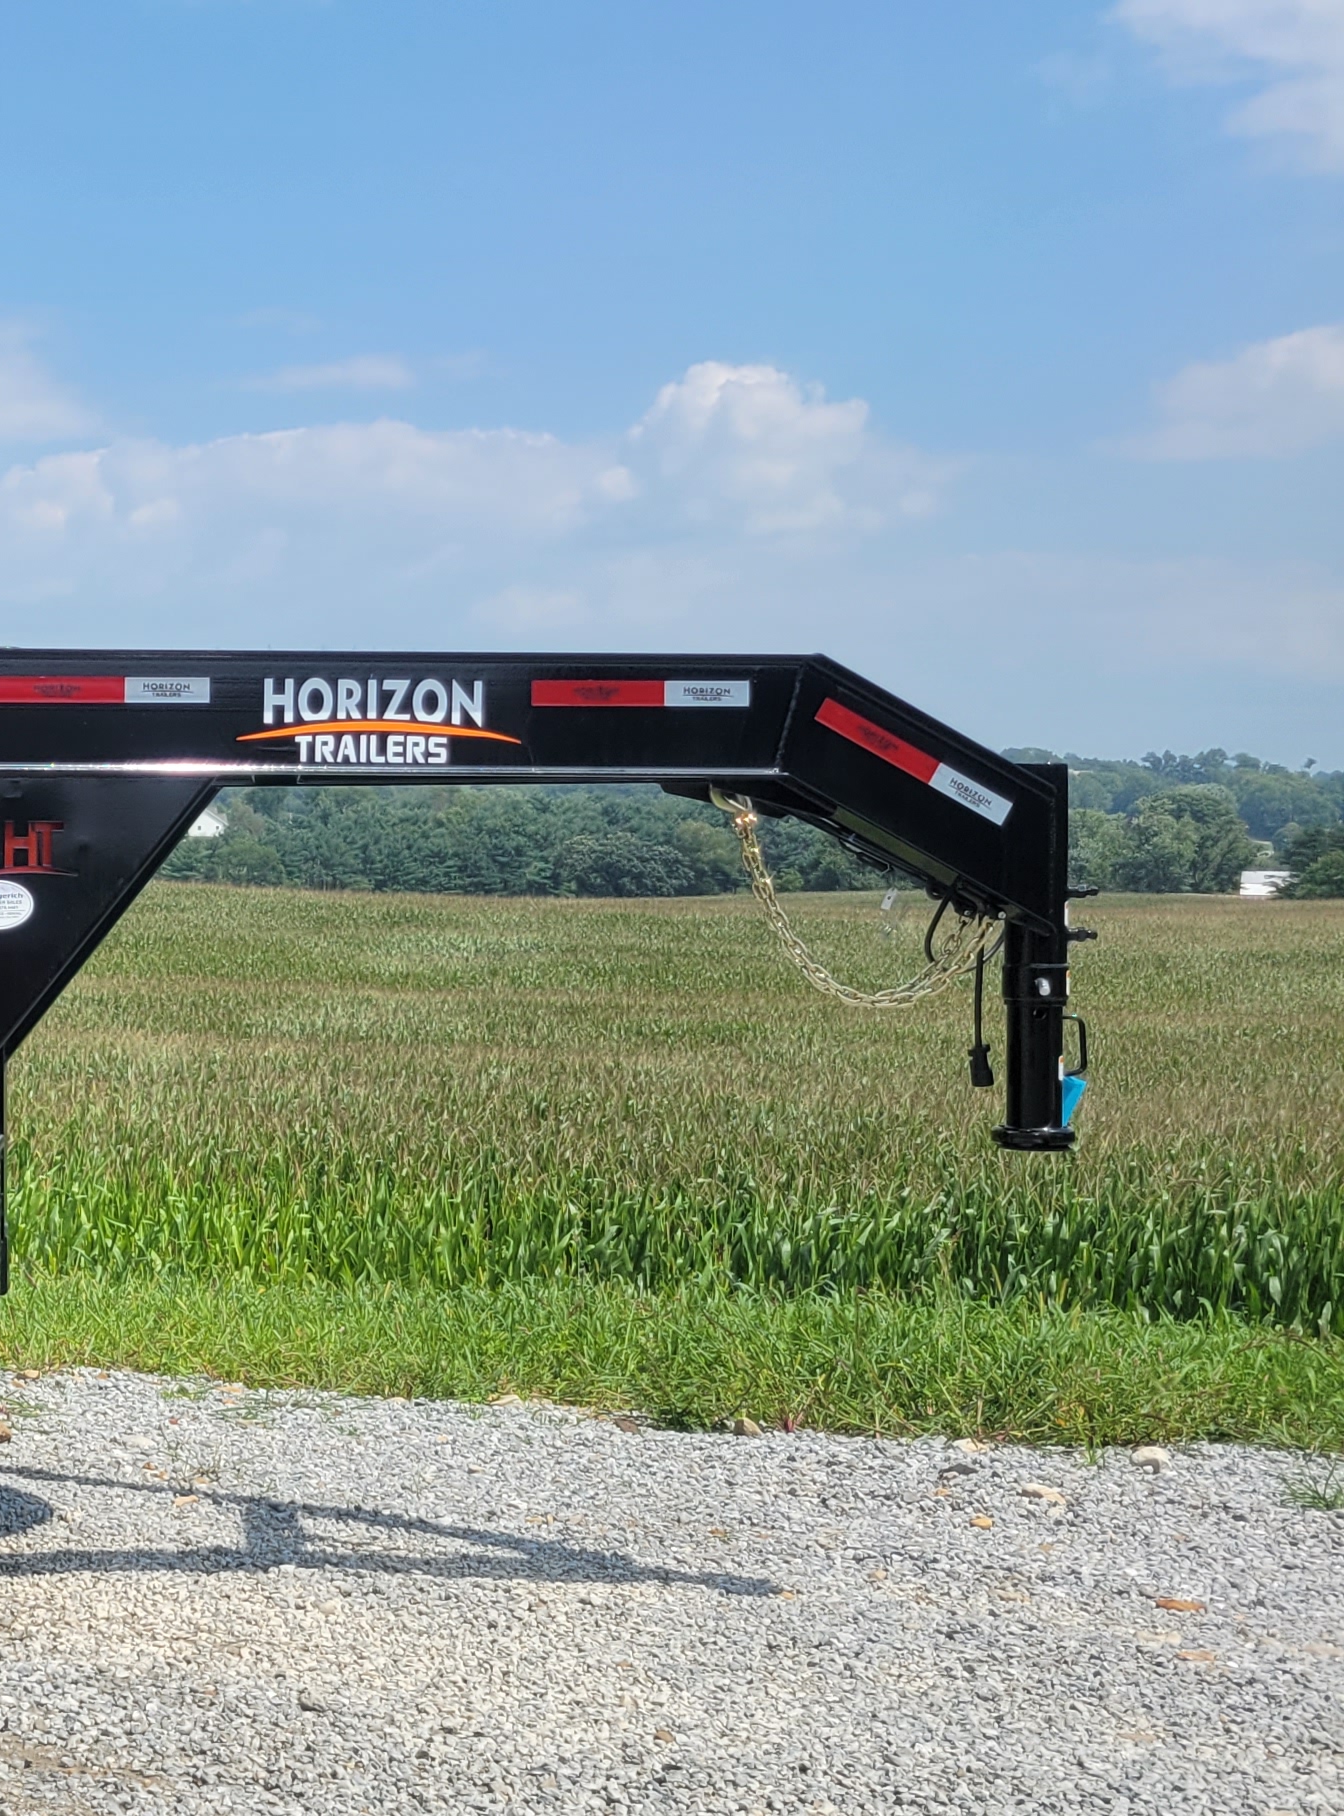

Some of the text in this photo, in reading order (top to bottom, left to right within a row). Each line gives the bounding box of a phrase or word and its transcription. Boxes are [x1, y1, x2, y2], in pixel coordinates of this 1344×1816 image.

[142, 682, 191, 691] HORIZON
[683, 686, 731, 696] HORIZON
[263, 677, 483, 728] HORIZON
[294, 734, 448, 764] TRAILERS
[949, 776, 993, 807] HORIZON
[3, 820, 65, 868] HT
